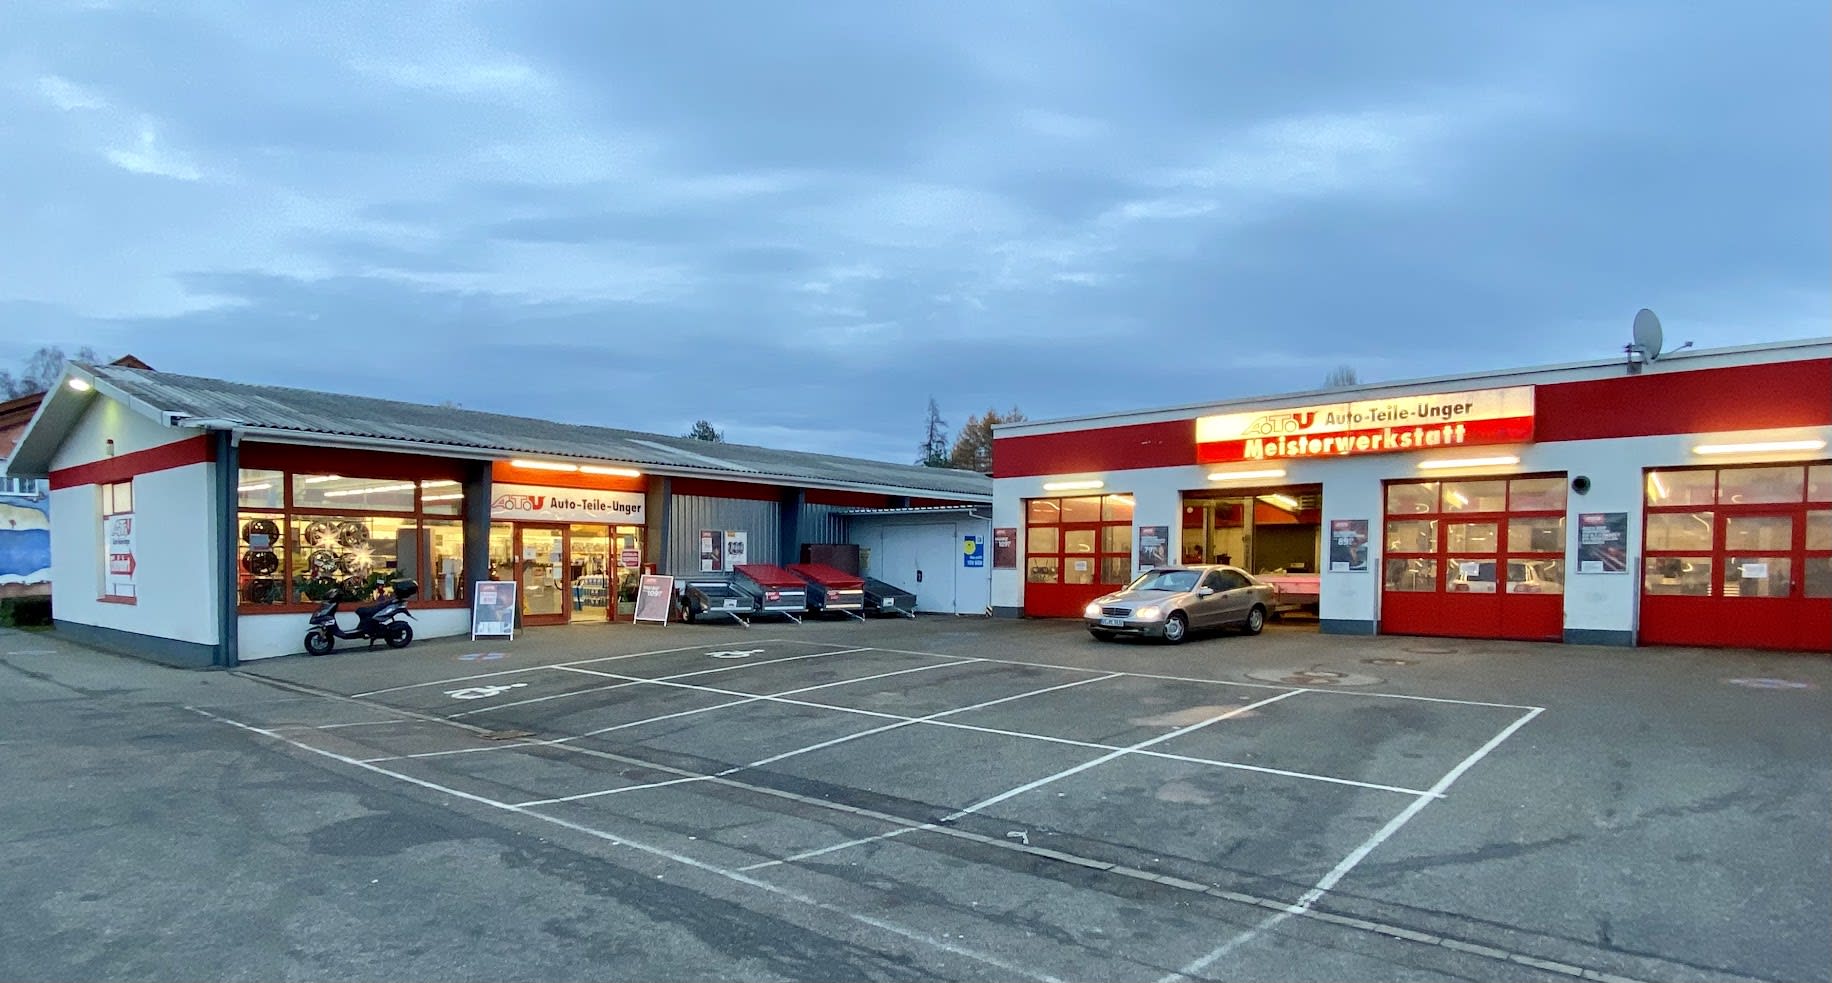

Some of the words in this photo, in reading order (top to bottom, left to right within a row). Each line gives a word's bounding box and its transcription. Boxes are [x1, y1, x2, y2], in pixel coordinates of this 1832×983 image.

[1326, 402, 1473, 425] Auto-Teile-Unger
[1244, 423, 1466, 460] Meisterwerkstatt
[550, 497, 642, 515] Auto-Teile-Unger
